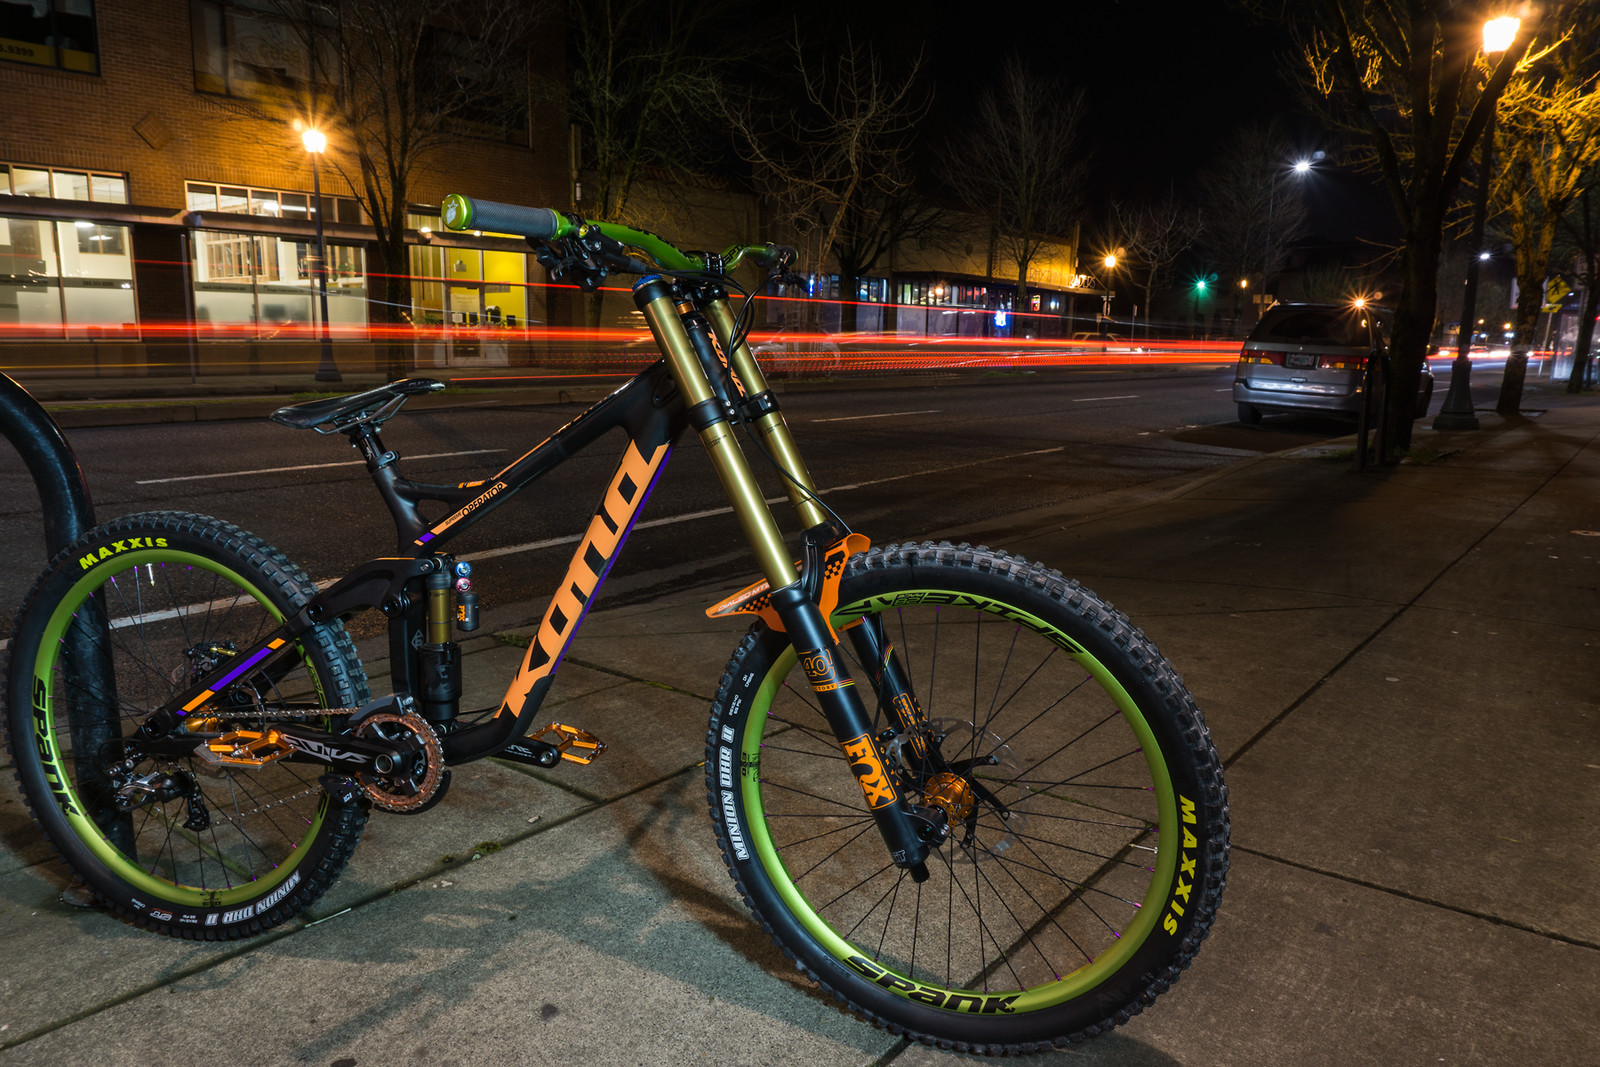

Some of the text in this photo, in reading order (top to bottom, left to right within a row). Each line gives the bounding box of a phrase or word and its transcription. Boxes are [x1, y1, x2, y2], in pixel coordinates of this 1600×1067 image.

[461, 483, 503, 517] OPERATOR
[79, 537, 168, 570] MAXXIS
[458, 604, 466, 622] FOX
[718, 592, 751, 612] DIALED
[922, 592, 1084, 654] SPIKE
[844, 736, 895, 807] FOX
[719, 724, 750, 861] MINION DHR II
[1163, 794, 1198, 936] MAXXIS
[255, 869, 301, 914] MINION
[222, 905, 254, 924] DHR
